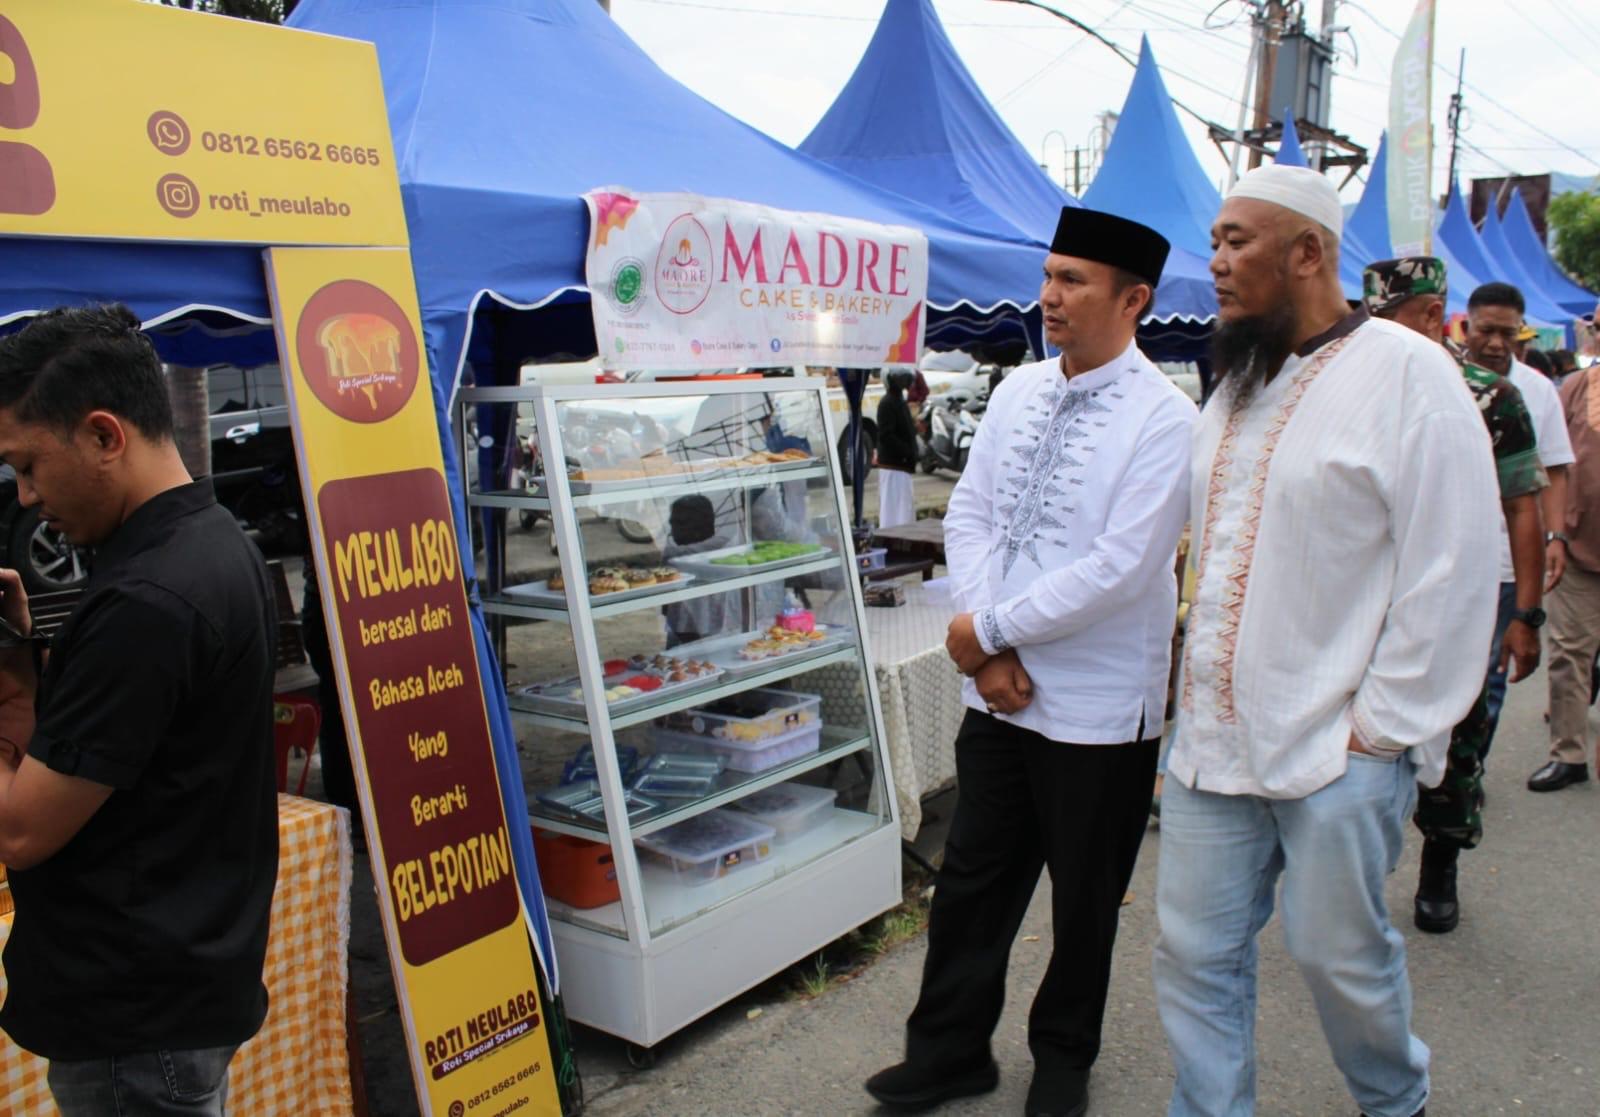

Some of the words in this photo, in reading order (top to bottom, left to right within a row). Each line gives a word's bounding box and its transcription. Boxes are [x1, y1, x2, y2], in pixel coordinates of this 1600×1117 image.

[201, 131, 260, 156] 0812
[264, 137, 322, 161] 6562
[326, 144, 380, 167] 6665
[209, 191, 351, 217] roti_meulabo
[720, 220, 910, 297] MADRE
[739, 288, 802, 309] CAKE
[825, 292, 893, 316] BAKERY
[334, 519, 456, 603] MEULABO
[359, 609, 418, 647] berasal
[421, 603, 452, 632] dari
[369, 674, 425, 711] Bahasa
[428, 663, 464, 695] Aceh
[408, 731, 449, 763] Yang
[411, 784, 468, 826] Berarti
[392, 826, 510, 922] BELEPOTAN
[425, 1027, 464, 1066] ROTI
[467, 990, 536, 1042] MEULABO
[443, 1058, 462, 1073] Roti
[464, 1039, 494, 1061] Special
[495, 1022, 528, 1044] Srikaya
[468, 1091, 490, 1109] 0812
[492, 1077, 515, 1095] 6562
[517, 1063, 540, 1081] 6665
